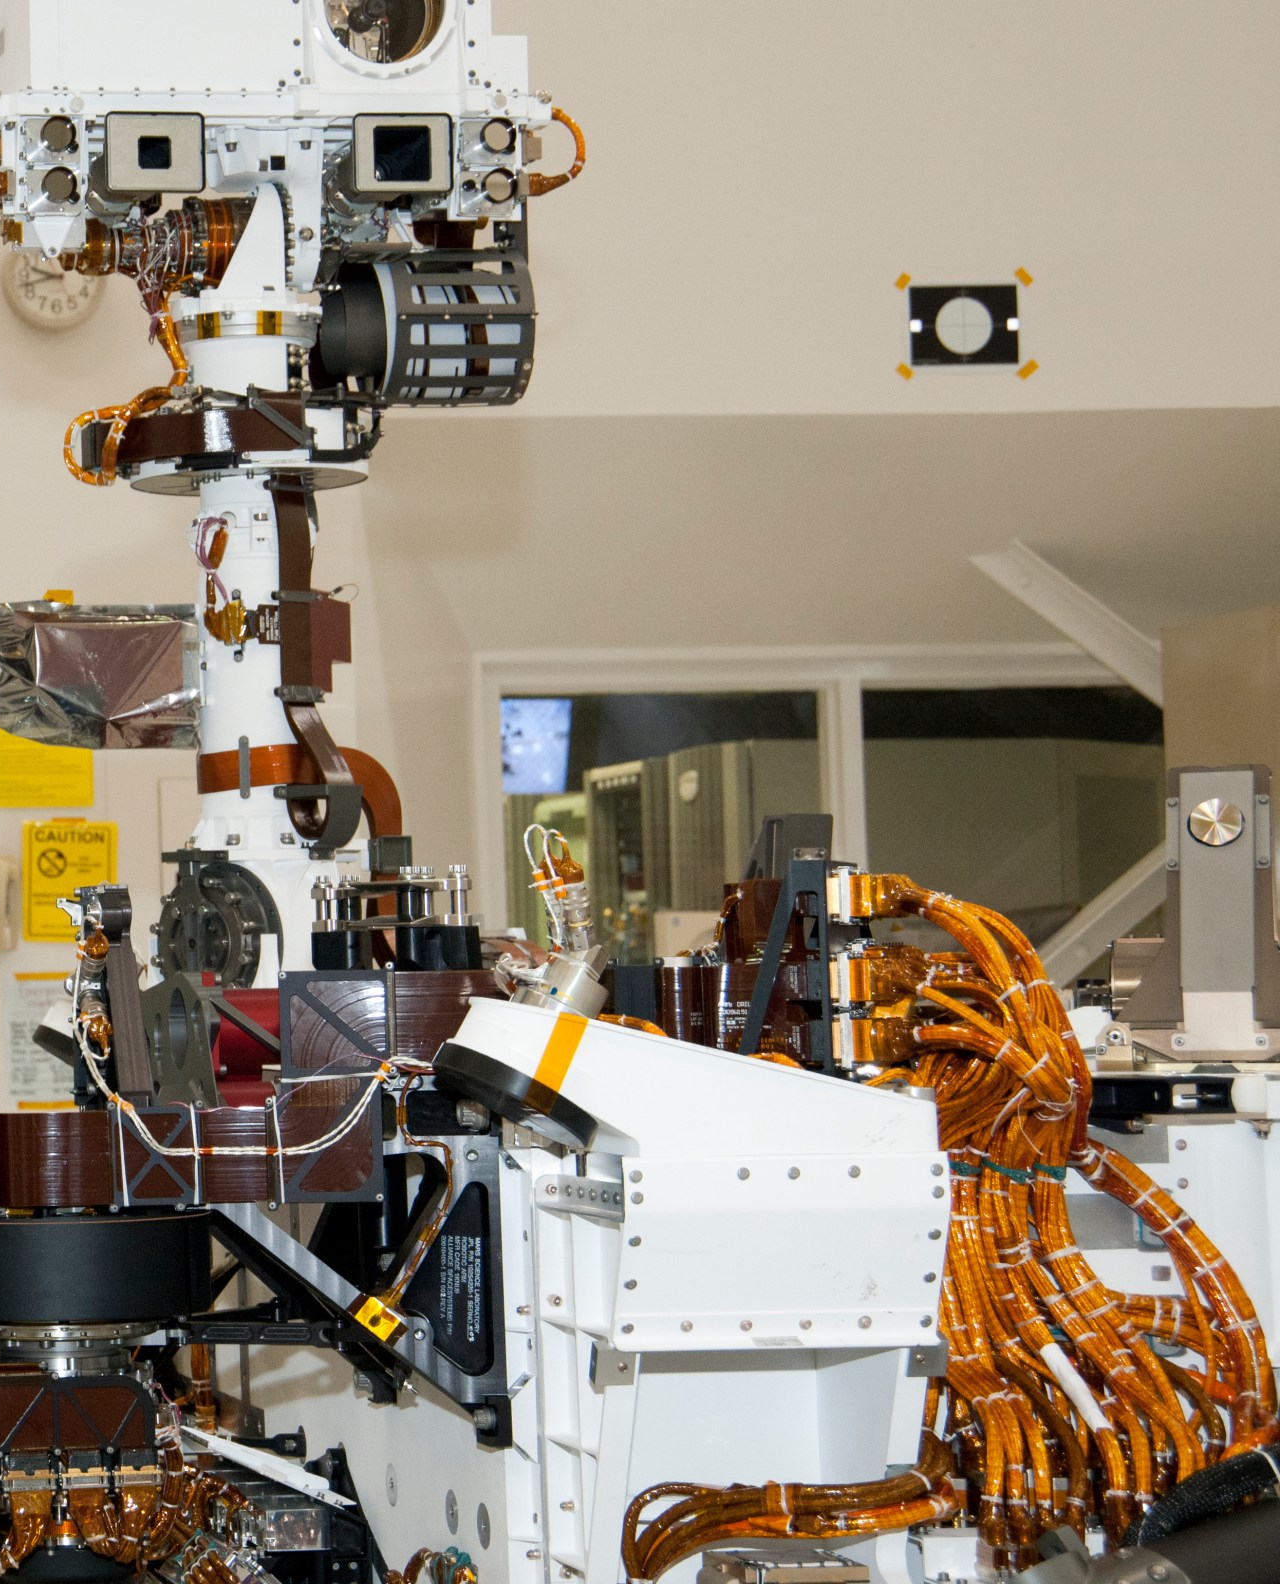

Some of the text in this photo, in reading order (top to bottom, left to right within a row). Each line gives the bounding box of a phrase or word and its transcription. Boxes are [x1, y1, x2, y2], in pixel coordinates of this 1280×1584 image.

[38, 295, 48, 310] 7
[50, 298, 62, 315] 6
[66, 294, 79, 310] 5
[34, 830, 104, 844] CAUTION
[473, 1288, 481, 1334] LABORATORY
